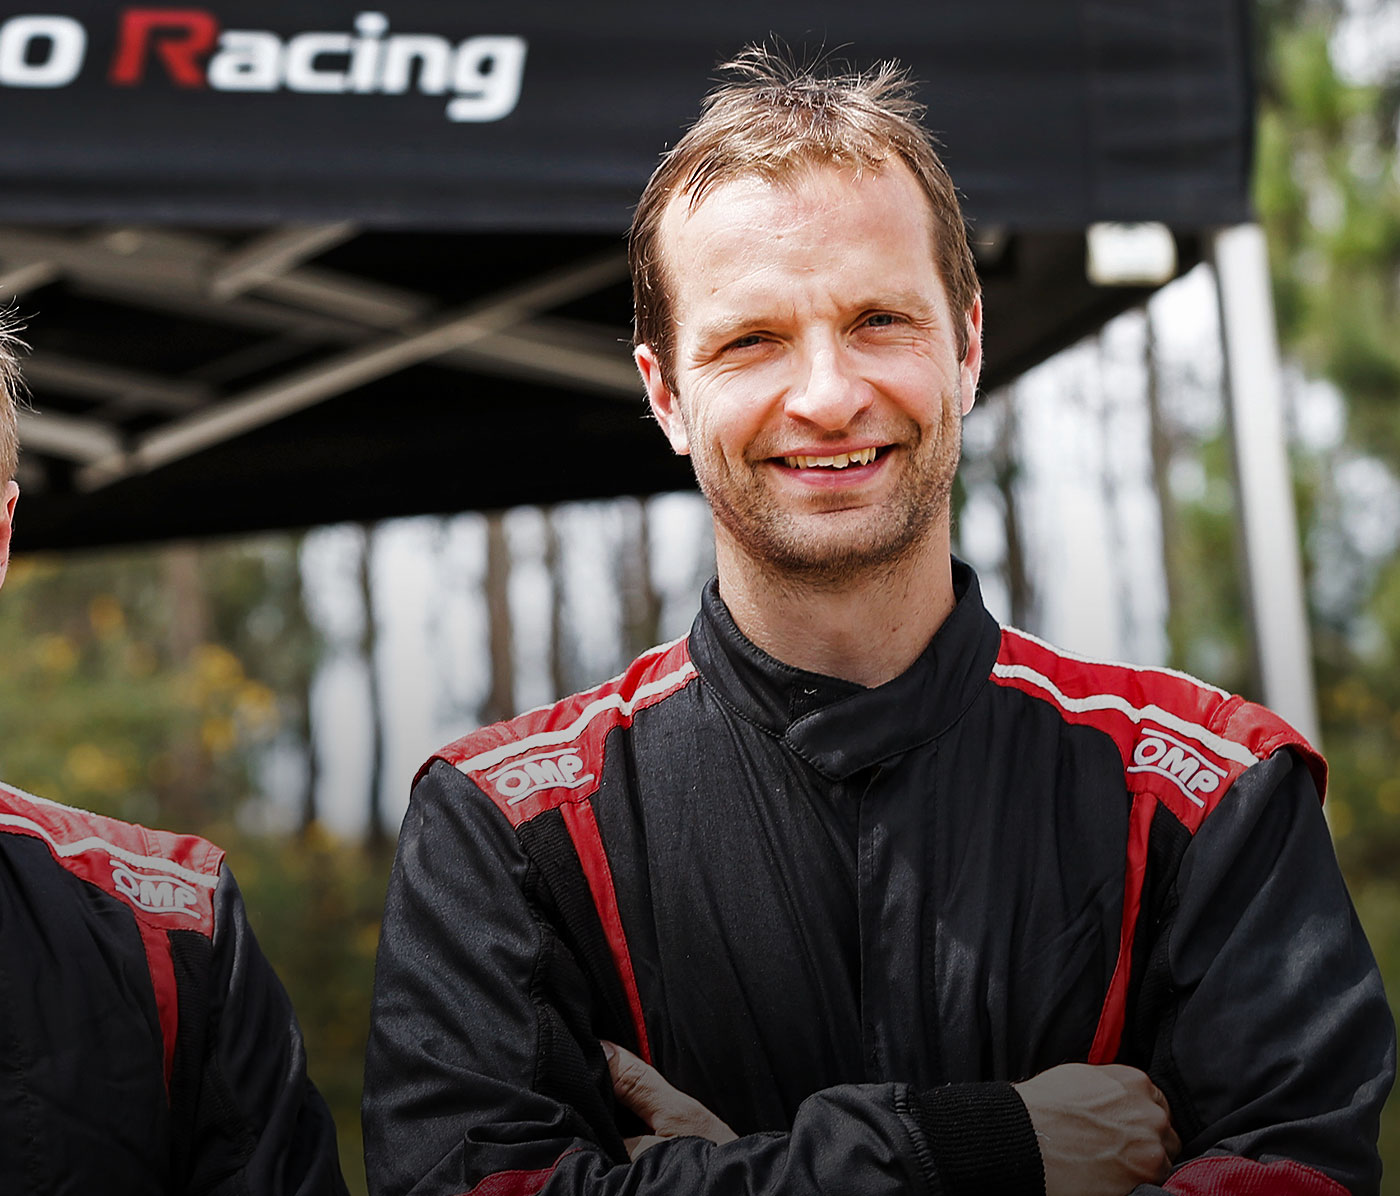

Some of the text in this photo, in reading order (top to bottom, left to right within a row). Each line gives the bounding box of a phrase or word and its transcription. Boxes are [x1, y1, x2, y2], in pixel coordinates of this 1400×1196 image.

[109, 8, 527, 122] Racing
[495, 754, 584, 797] OMP
[1133, 737, 1220, 793] OMP
[111, 868, 198, 908] OMP
